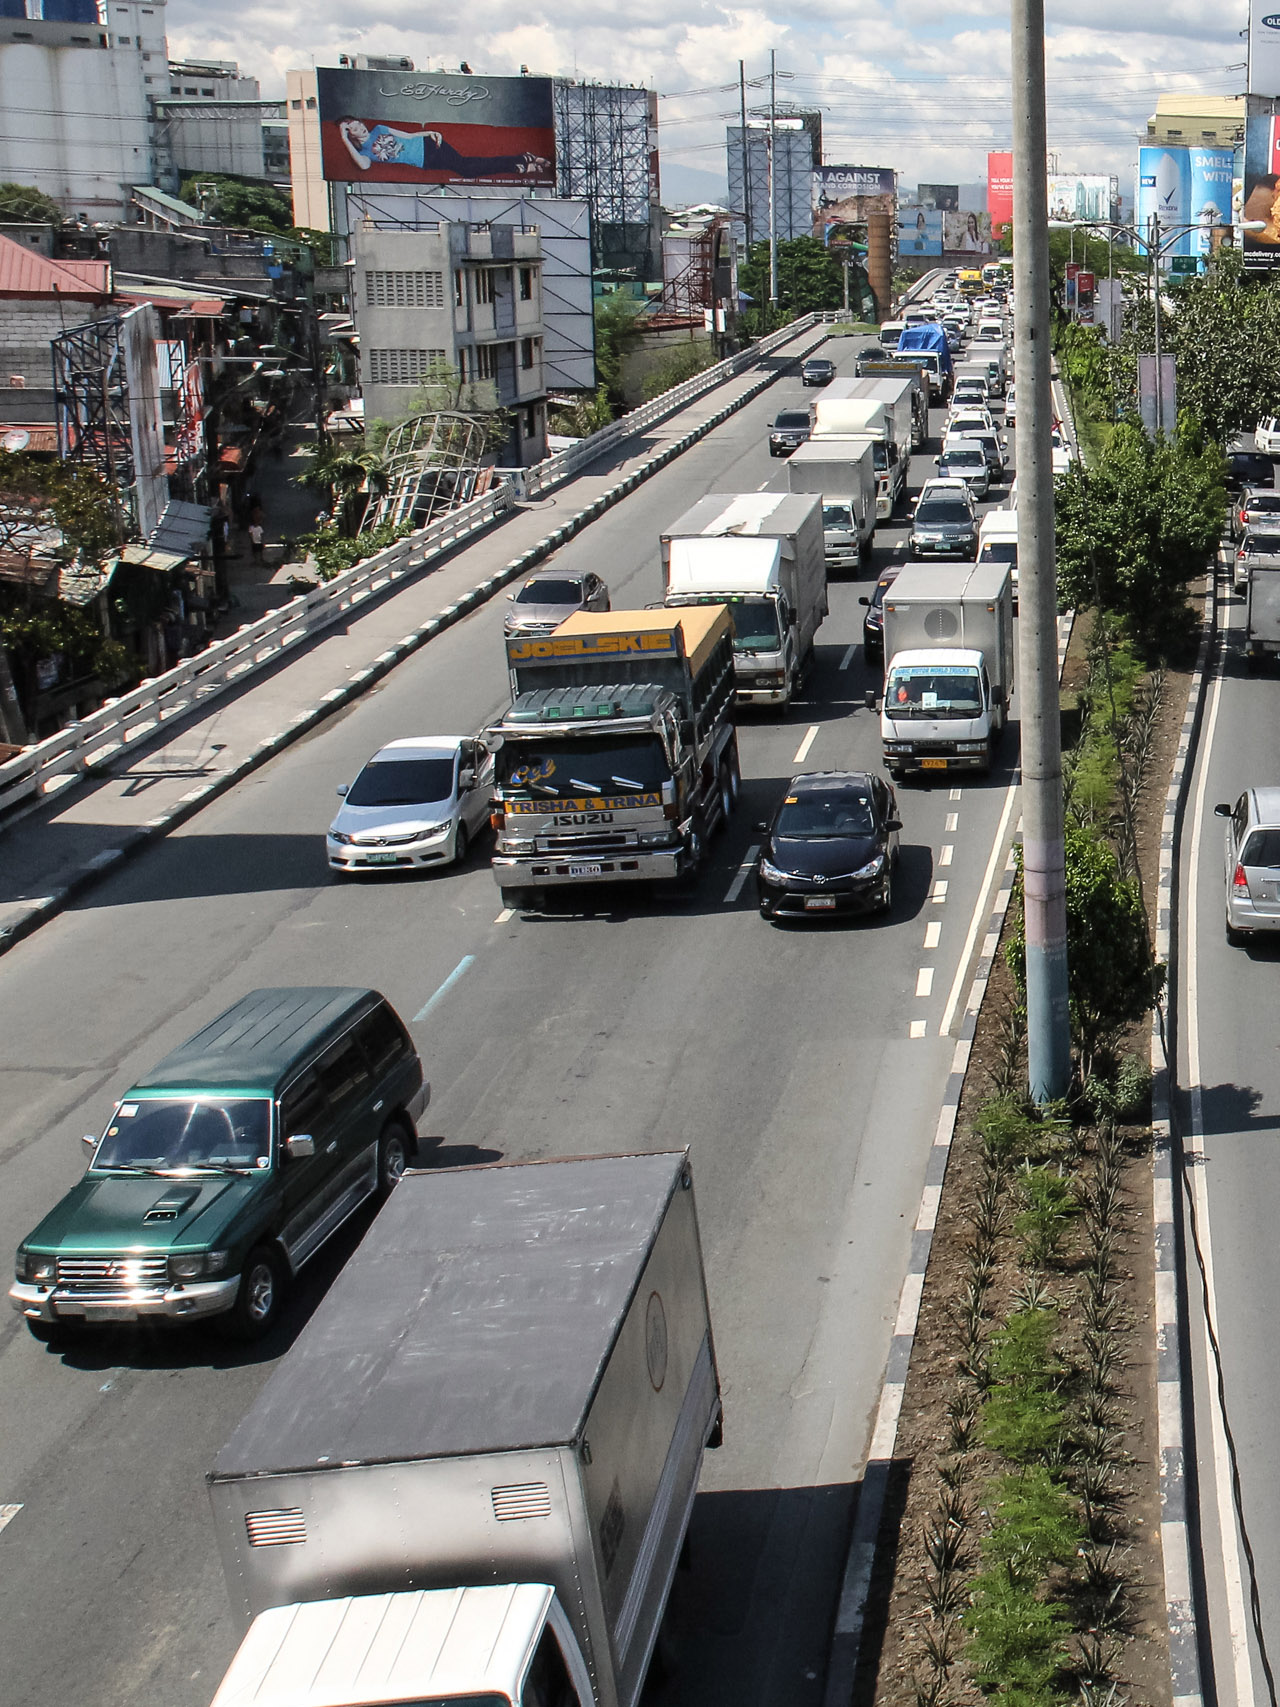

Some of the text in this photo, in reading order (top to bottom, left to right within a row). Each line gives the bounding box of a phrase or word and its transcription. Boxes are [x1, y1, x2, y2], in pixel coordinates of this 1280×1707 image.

[400, 82, 480, 106] Ed Hardy
[1195, 156, 1232, 169] SMELL
[827, 172, 880, 184] AGAINST
[1203, 170, 1232, 183] WITH
[510, 634, 673, 660] JOELSKIE
[507, 794, 658, 813] TRISHA & TRINA
[553, 812, 614, 827] ISUZU
